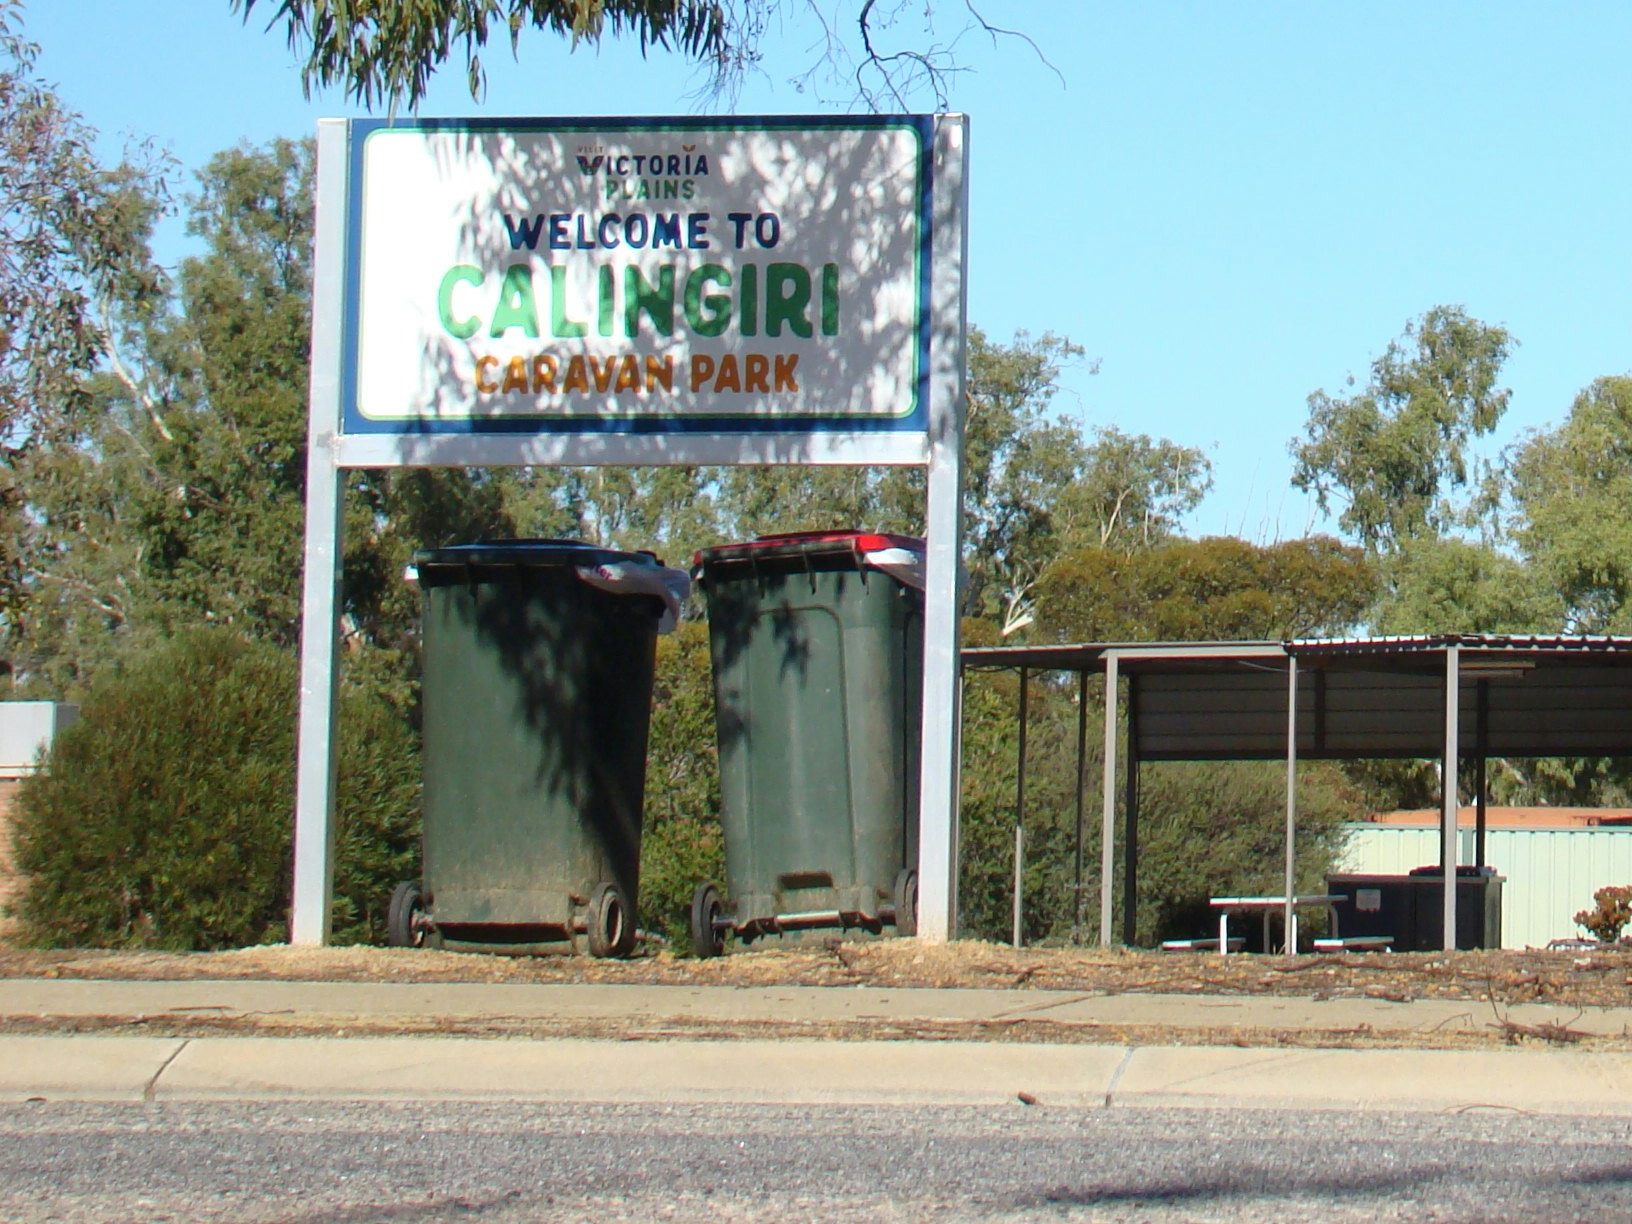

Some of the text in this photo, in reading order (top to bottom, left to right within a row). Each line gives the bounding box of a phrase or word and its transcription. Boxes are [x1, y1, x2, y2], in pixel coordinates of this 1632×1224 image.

[575, 154, 709, 176] VICTORIA
[606, 179, 696, 200] PLAINS
[503, 212, 781, 250] WELCOME TO
[437, 262, 840, 339] CALINGIRI
[474, 353, 800, 395] CARAVAN PARK
